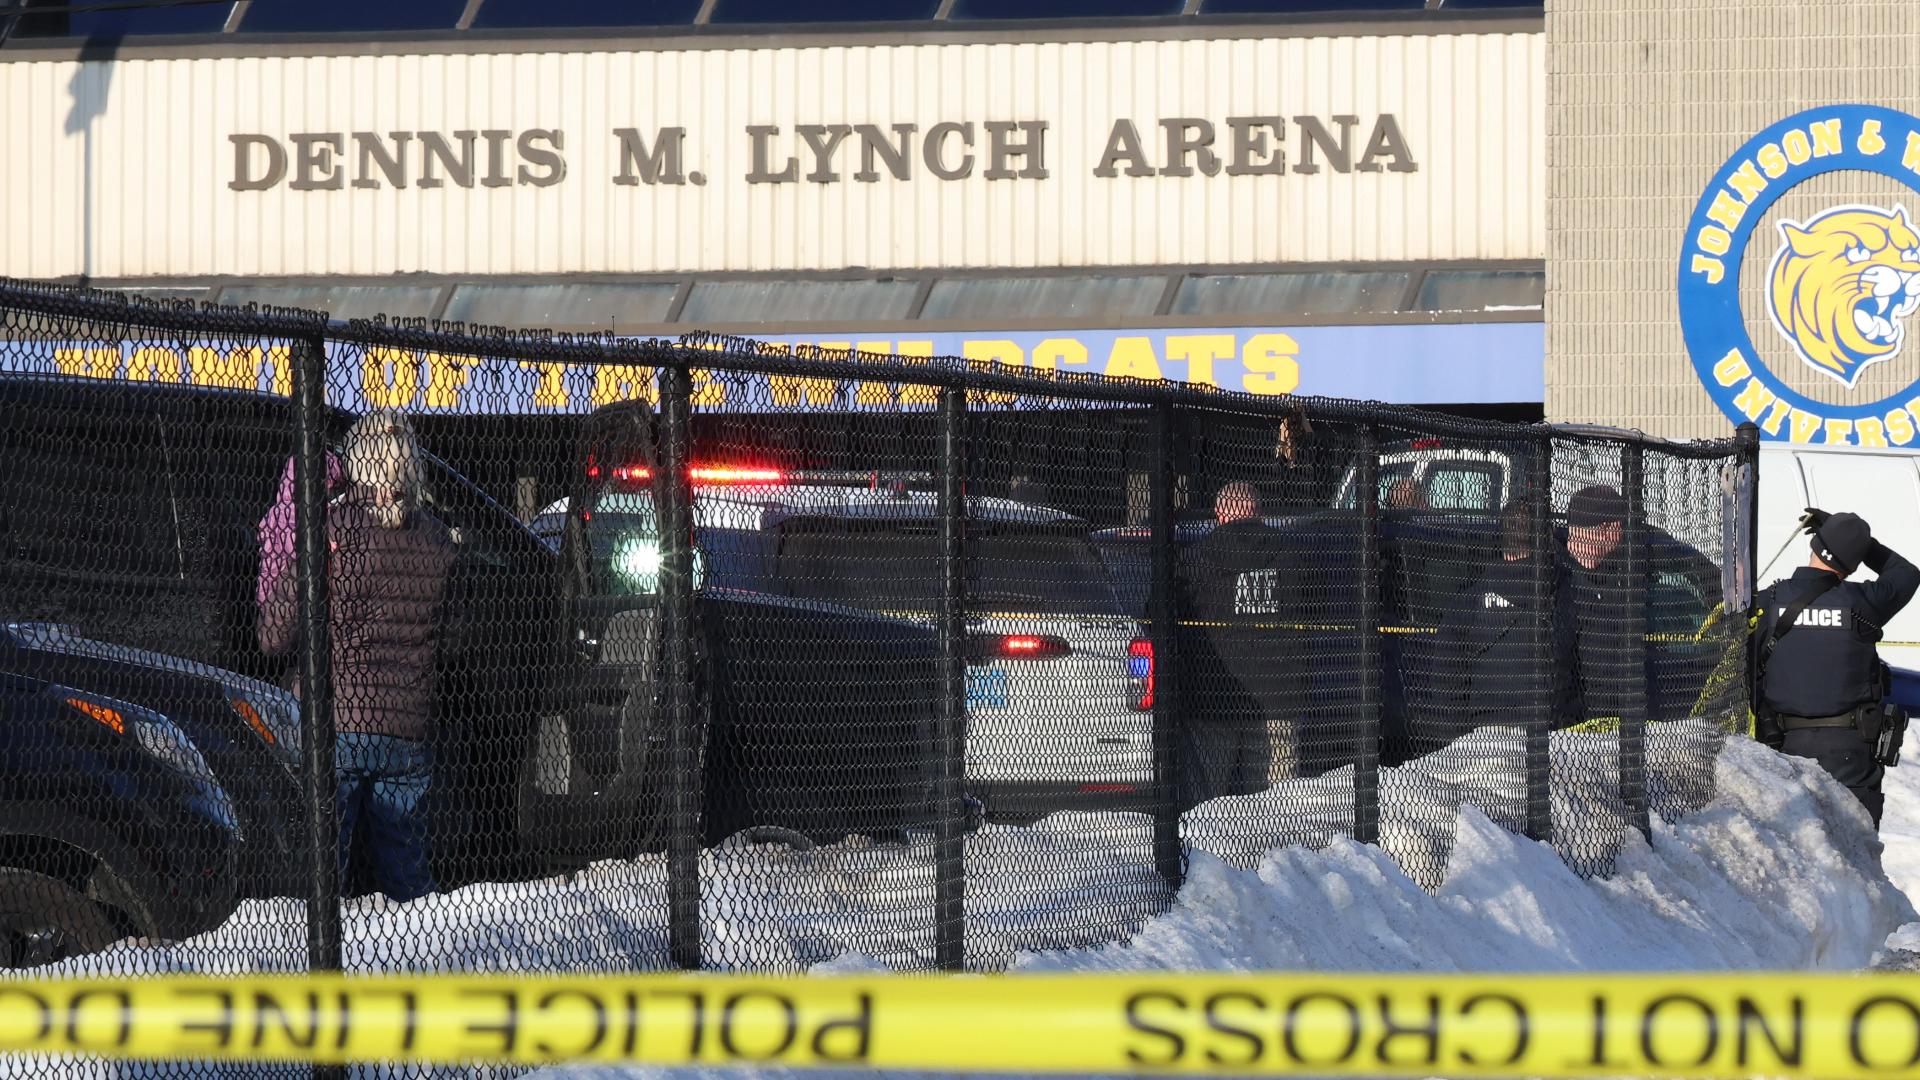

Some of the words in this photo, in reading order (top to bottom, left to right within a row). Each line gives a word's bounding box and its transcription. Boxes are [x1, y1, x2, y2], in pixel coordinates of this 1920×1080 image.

[227, 130, 566, 192] DENNIS
[613, 127, 707, 186] M.
[745, 120, 1050, 184] LYNCH
[1093, 113, 1419, 177] ARENA
[1691, 118, 1843, 285] JOHNSON
[1857, 119, 1886, 155] &
[1779, 607, 1842, 627] LICE
[180, 984, 420, 1060] LINE
[456, 986, 876, 1063] POLICE
[1122, 988, 1534, 1070] CROSS
[1562, 992, 1806, 1071] NOT
[1846, 991, 1920, 1070] O
